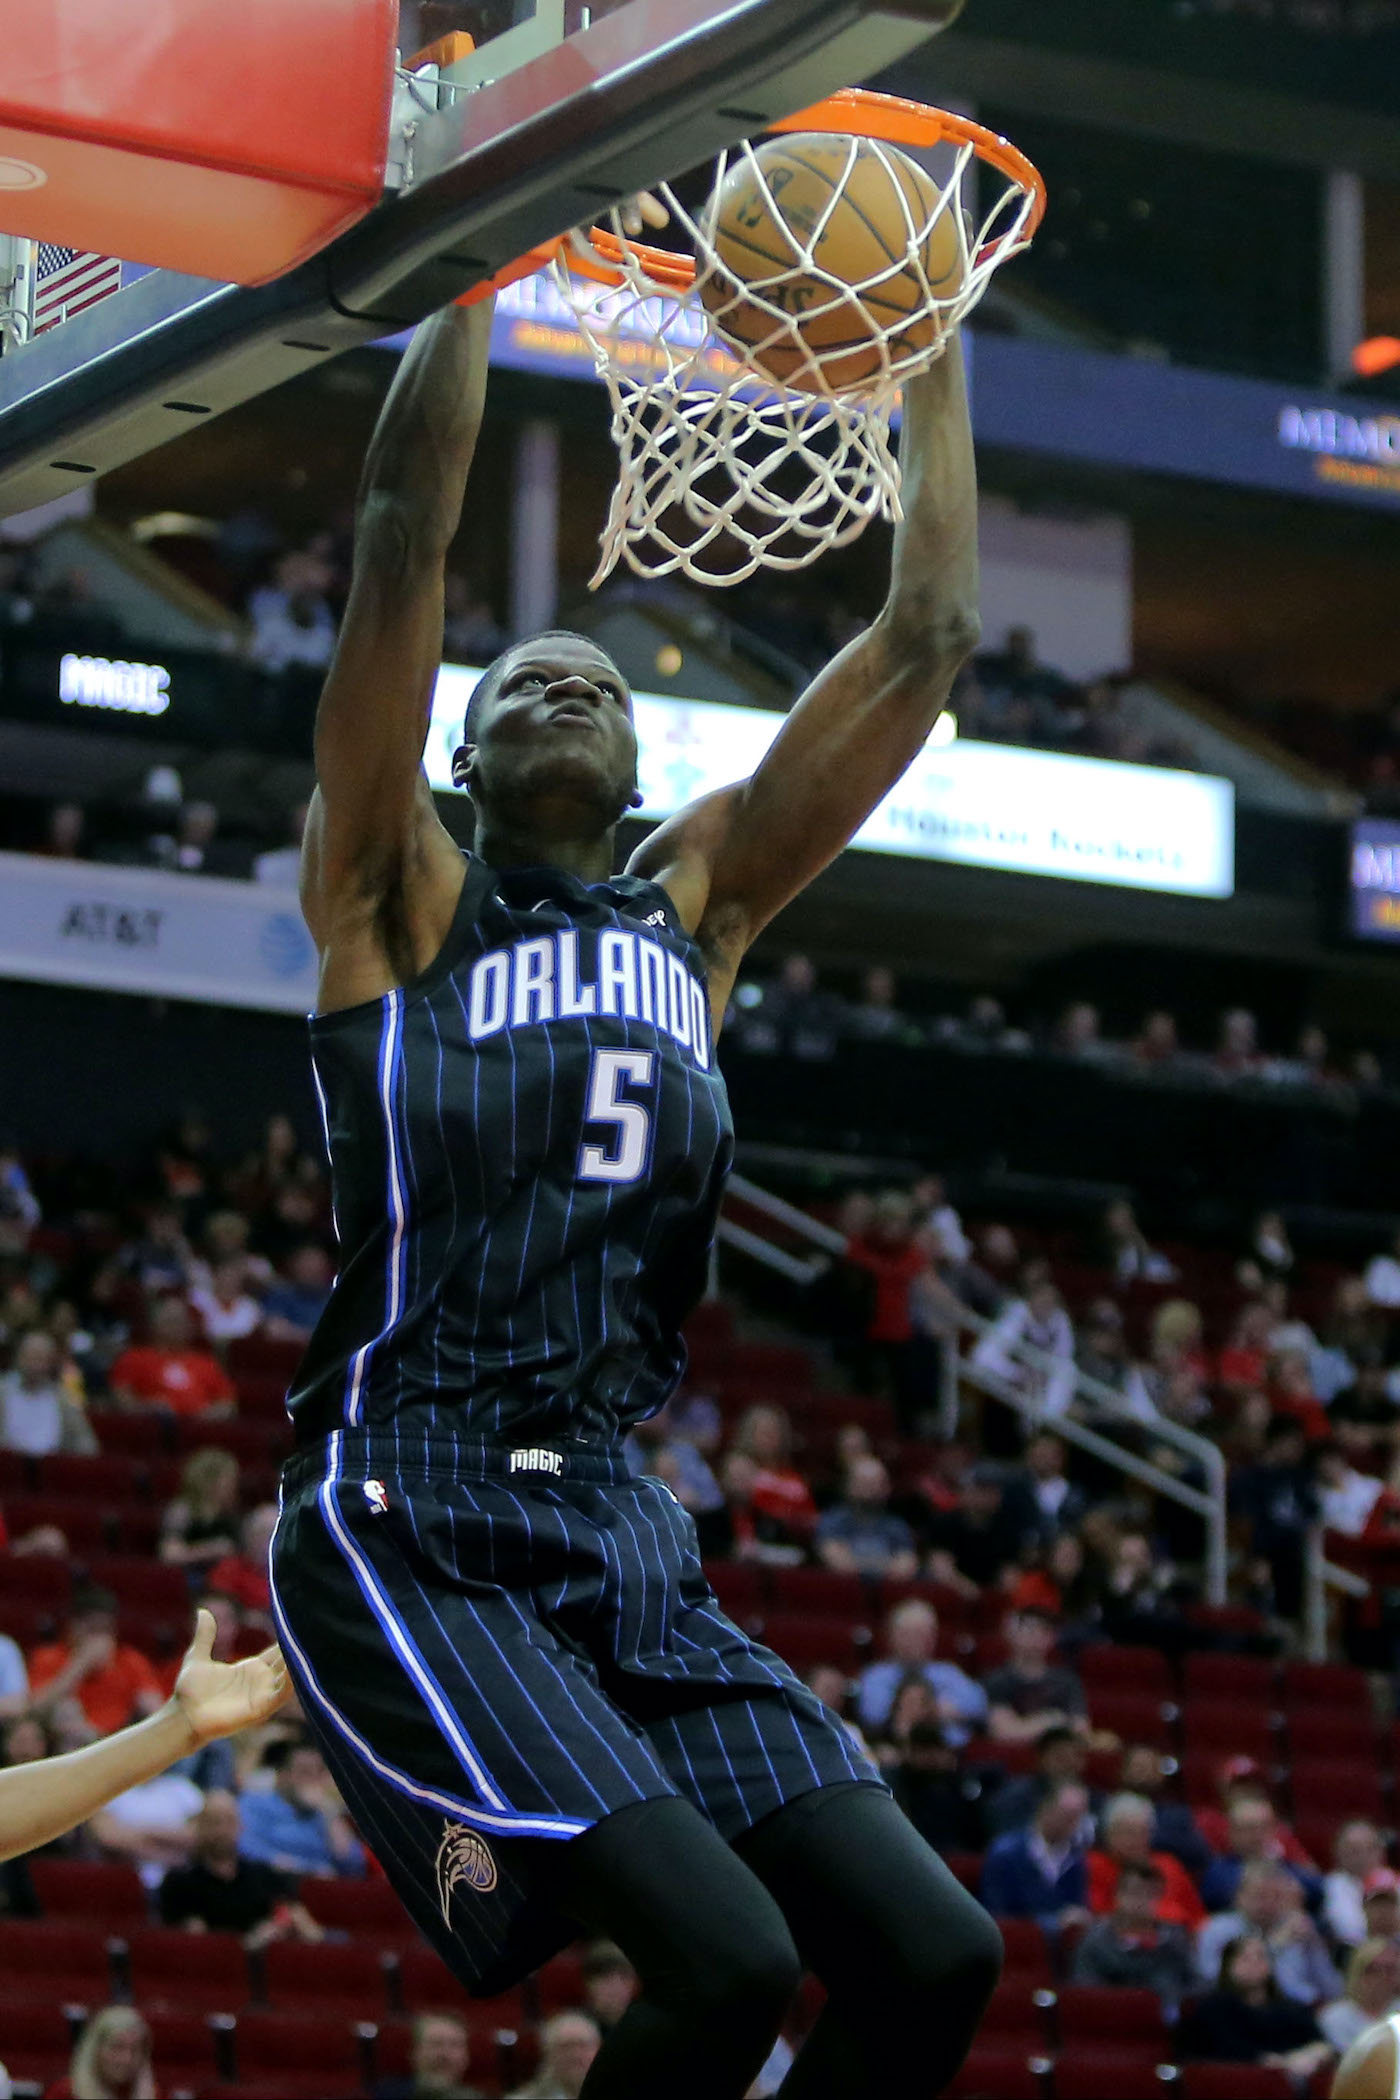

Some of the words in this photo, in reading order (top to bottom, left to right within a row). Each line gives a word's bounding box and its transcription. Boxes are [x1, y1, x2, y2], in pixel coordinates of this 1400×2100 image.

[60, 903, 166, 948] AT&T
[468, 926, 713, 1073] ORLANDO
[575, 1046, 657, 1184] 5
[509, 1448, 565, 1477] MAGIC
